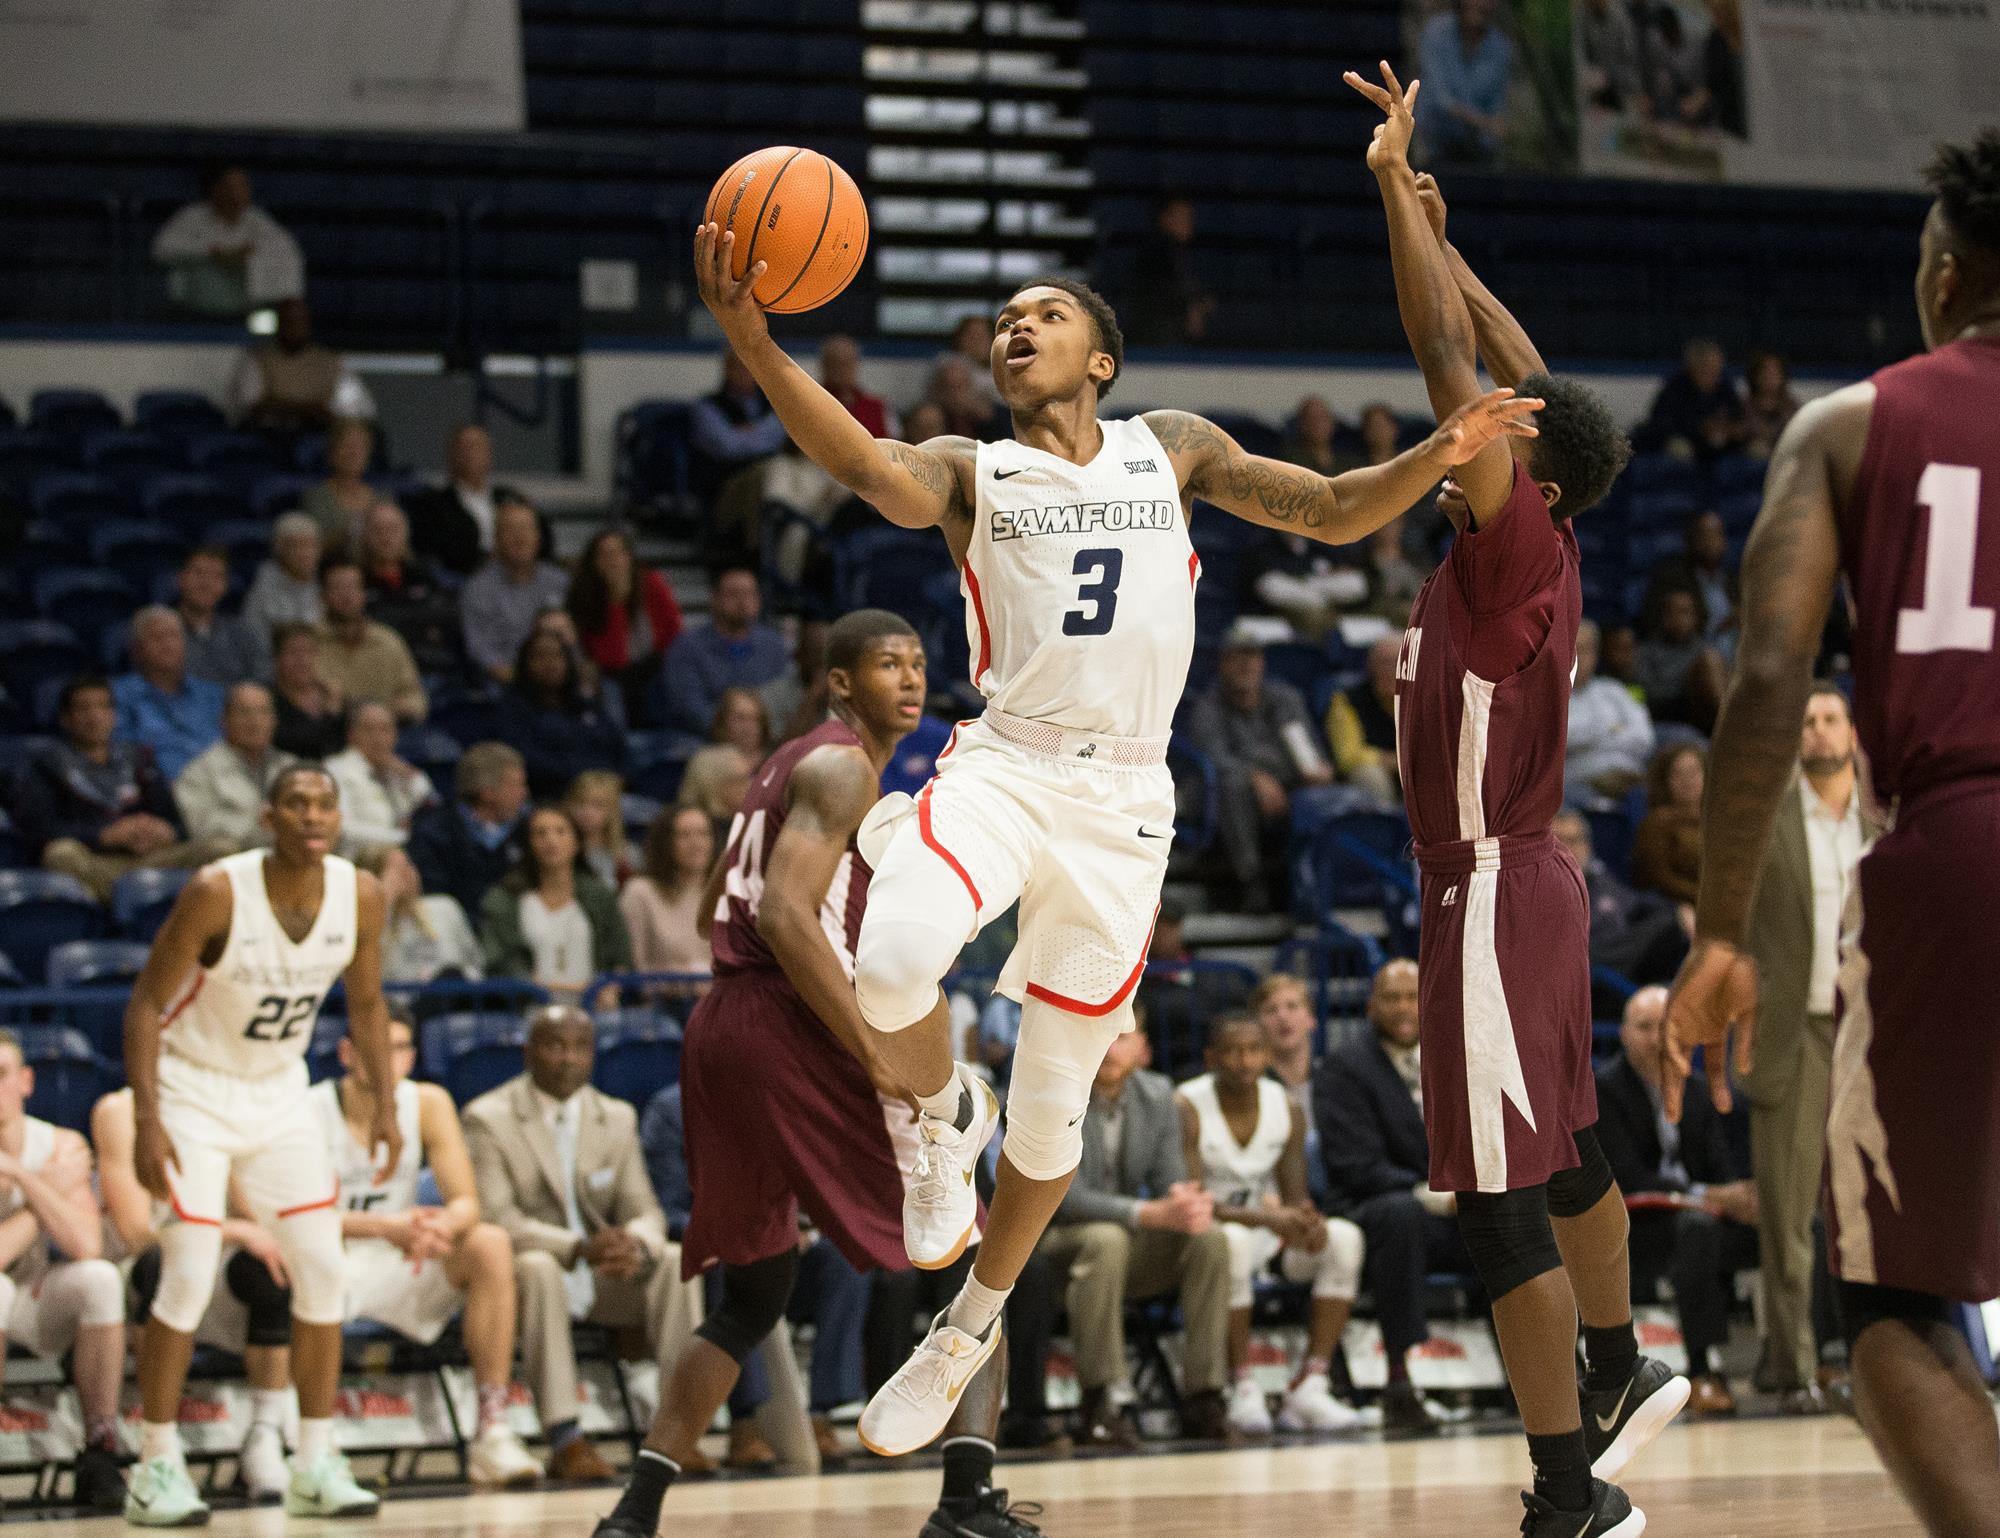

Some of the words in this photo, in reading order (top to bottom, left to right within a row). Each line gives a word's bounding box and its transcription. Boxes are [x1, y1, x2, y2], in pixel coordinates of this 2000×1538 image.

[1123, 459, 1158, 474] SOCON
[991, 500, 1172, 541] SAMFORD
[1895, 461, 1996, 654] 1
[1062, 548, 1123, 636] 3
[242, 994, 317, 1041] 22
